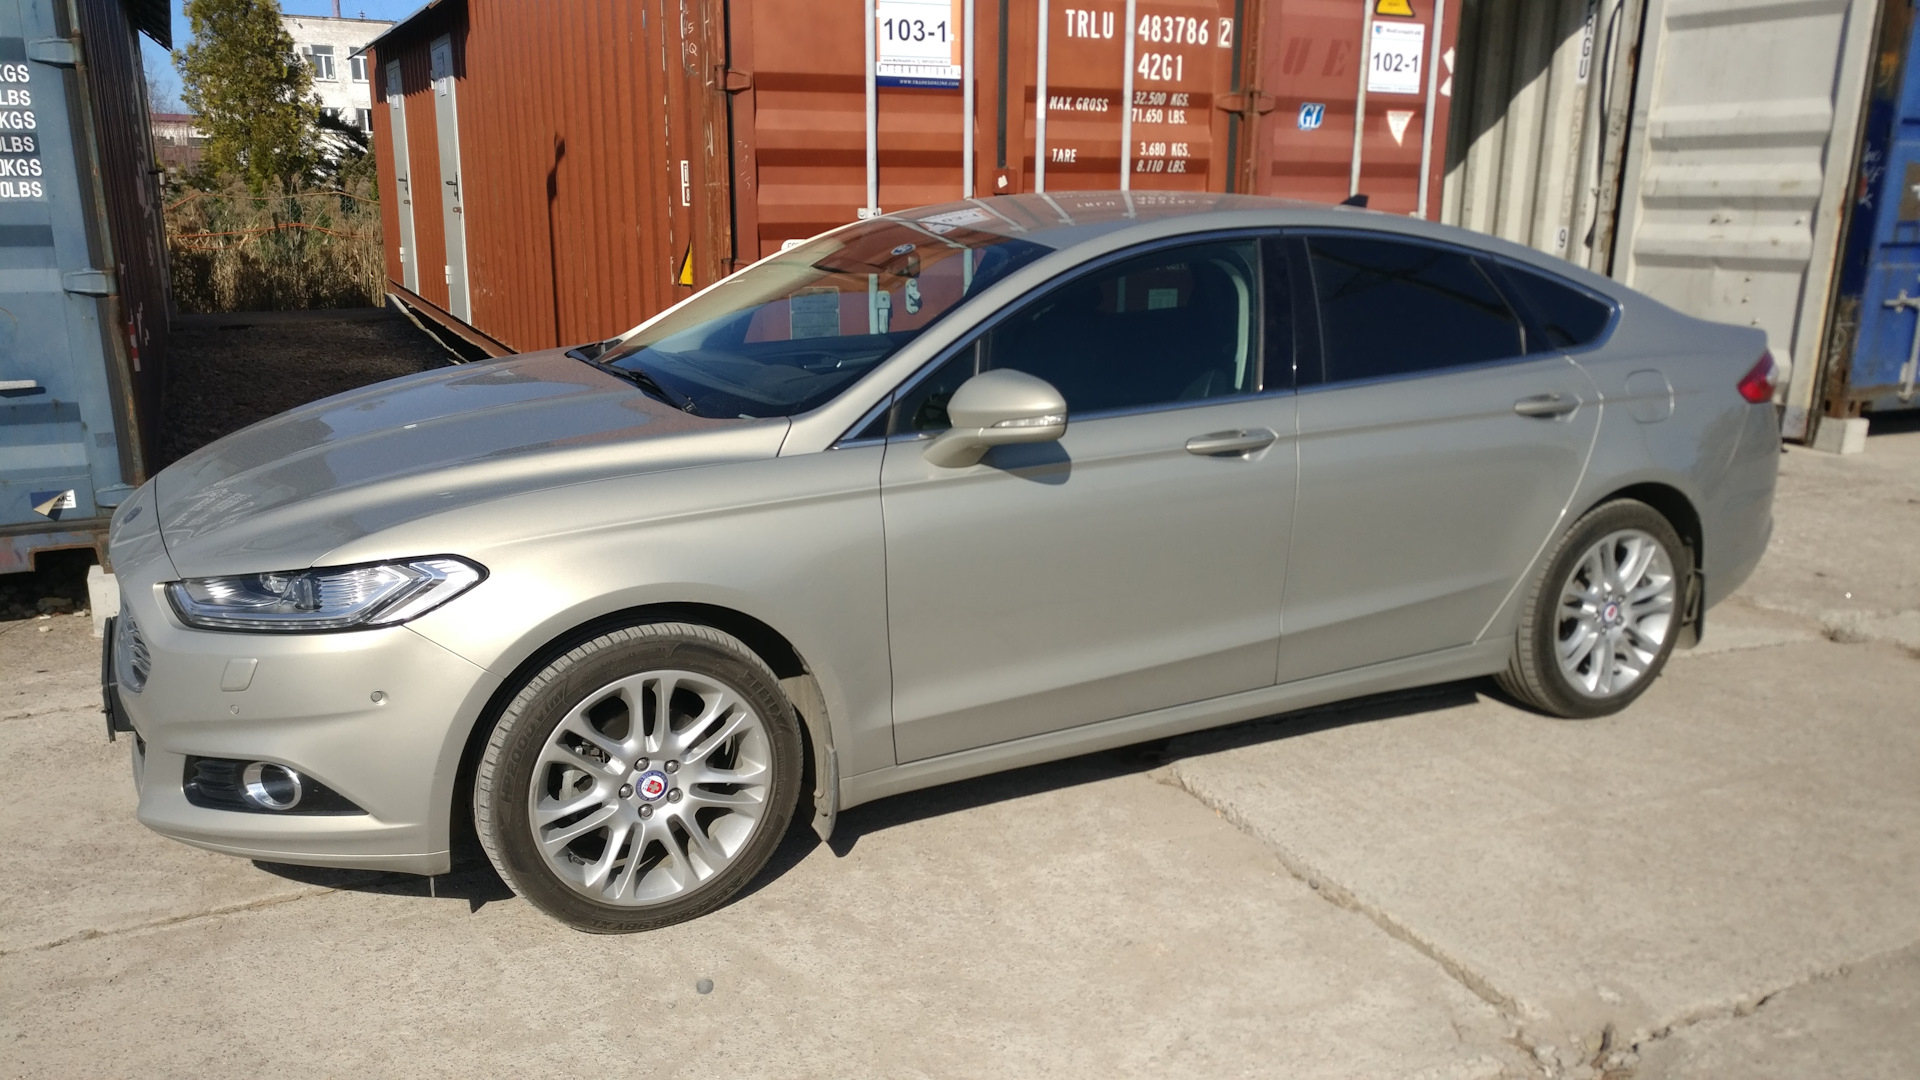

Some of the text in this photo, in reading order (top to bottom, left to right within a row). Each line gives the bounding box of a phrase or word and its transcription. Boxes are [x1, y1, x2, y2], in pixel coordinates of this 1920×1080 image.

[884, 18, 946, 42] 103-1
[1065, 9, 1232, 47] TRLU 483786 2
[1137, 53, 1183, 81] 42G1
[1373, 51, 1419, 74] 102-1
[1133, 91, 1167, 106] 32.500
[1132, 108, 1164, 123] 71.650
[1052, 148, 1077, 163] TARE
[1140, 141, 1166, 156] 3.680
[1136, 160, 1164, 173] 8.110
